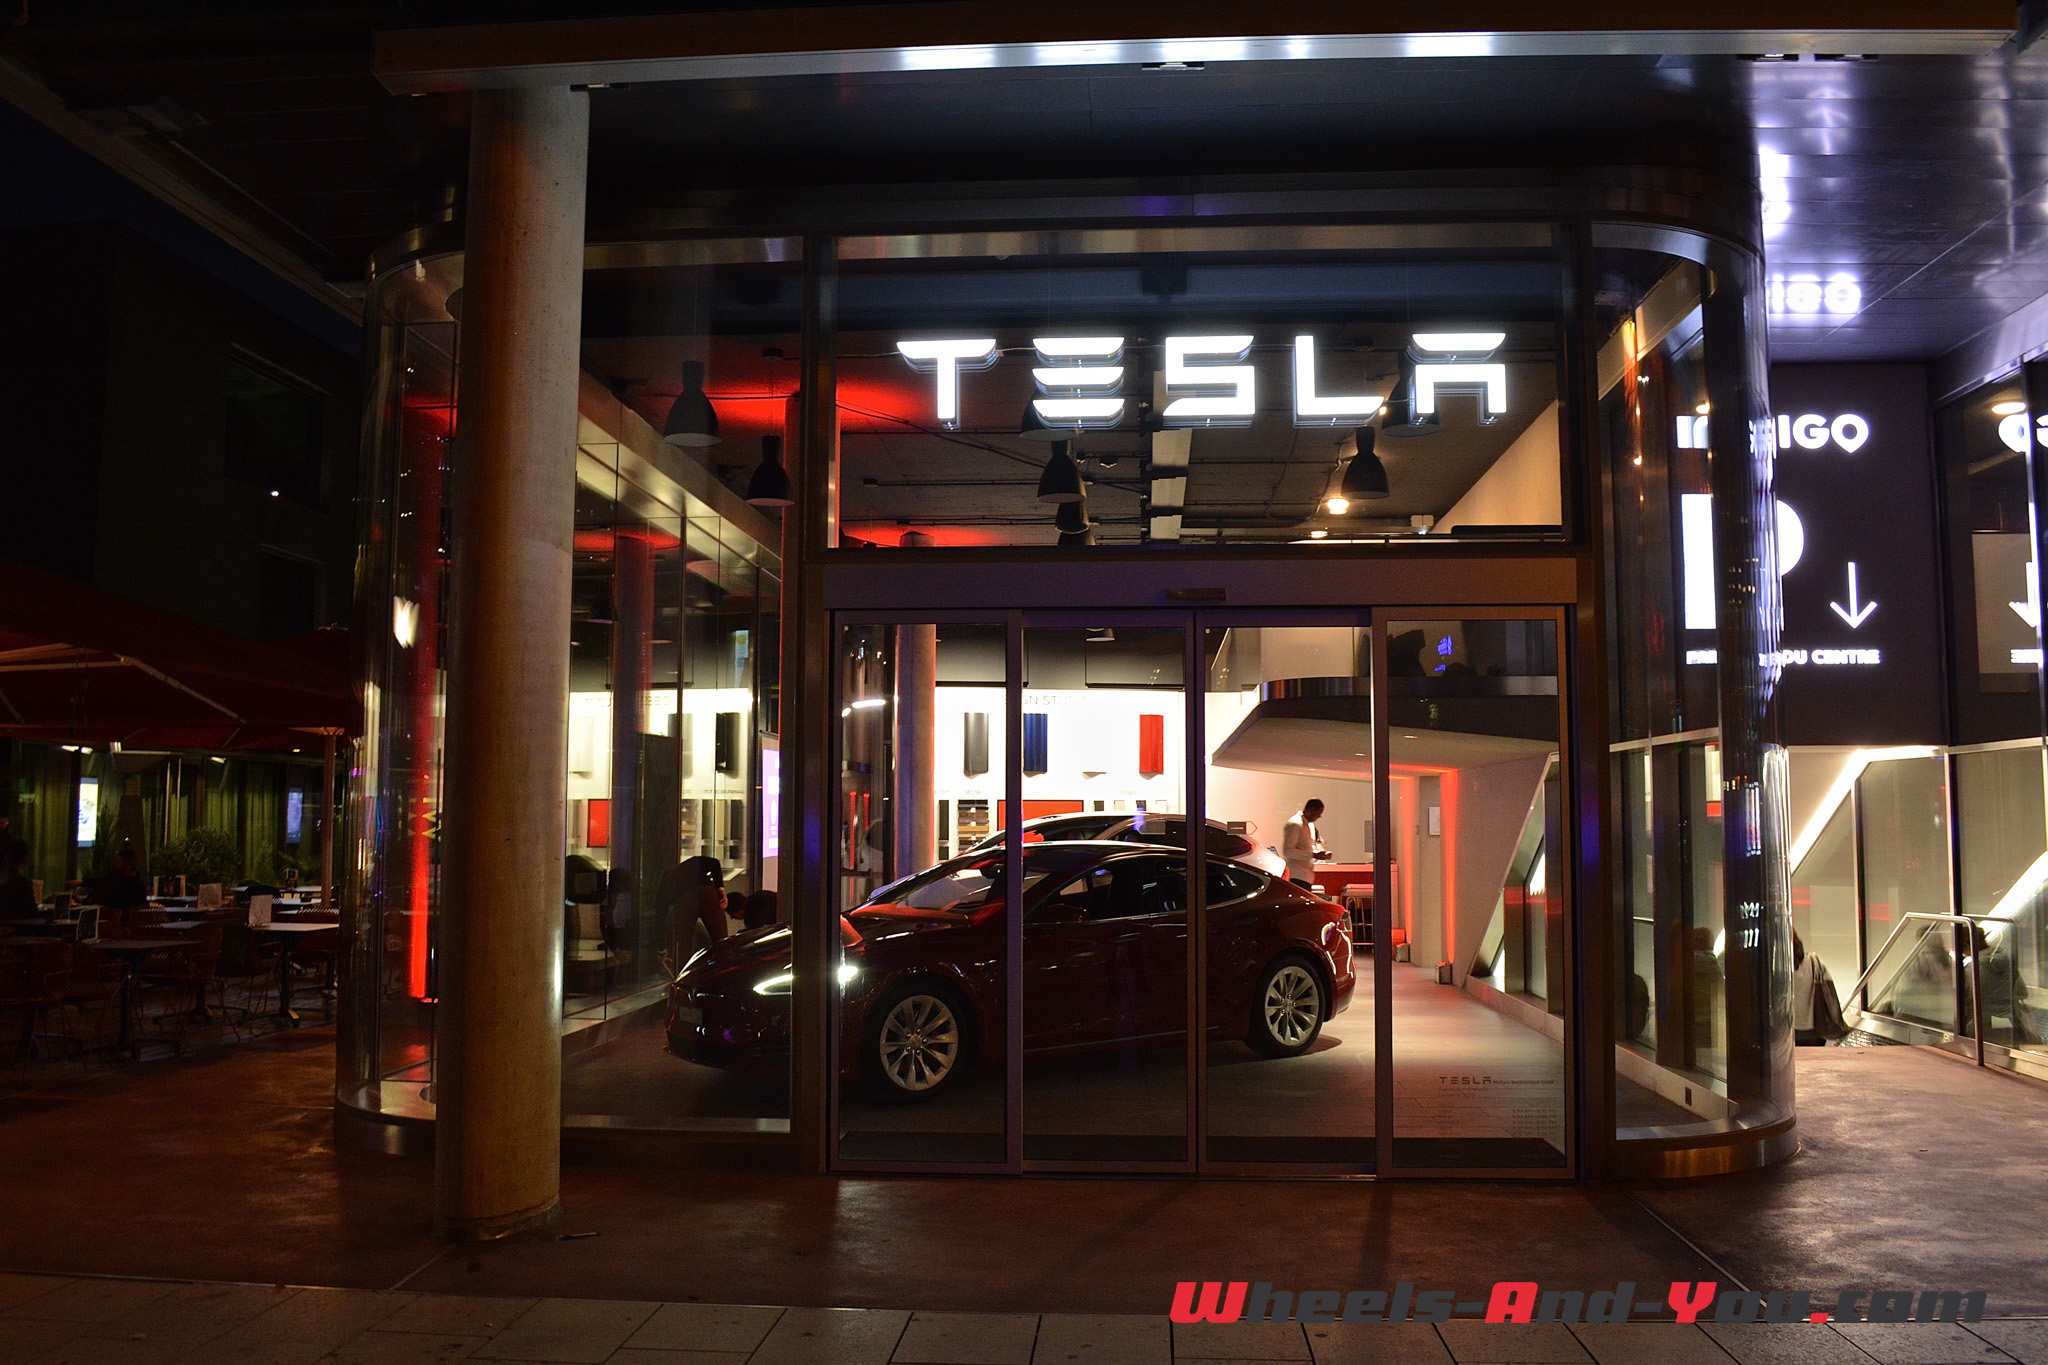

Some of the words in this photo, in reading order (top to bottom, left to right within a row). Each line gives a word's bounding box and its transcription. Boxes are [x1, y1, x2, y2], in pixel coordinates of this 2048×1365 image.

[897, 332, 1507, 421] TESLA
[1811, 649, 1881, 664] CENTRE
[1439, 1076, 1492, 1085] TESLA
